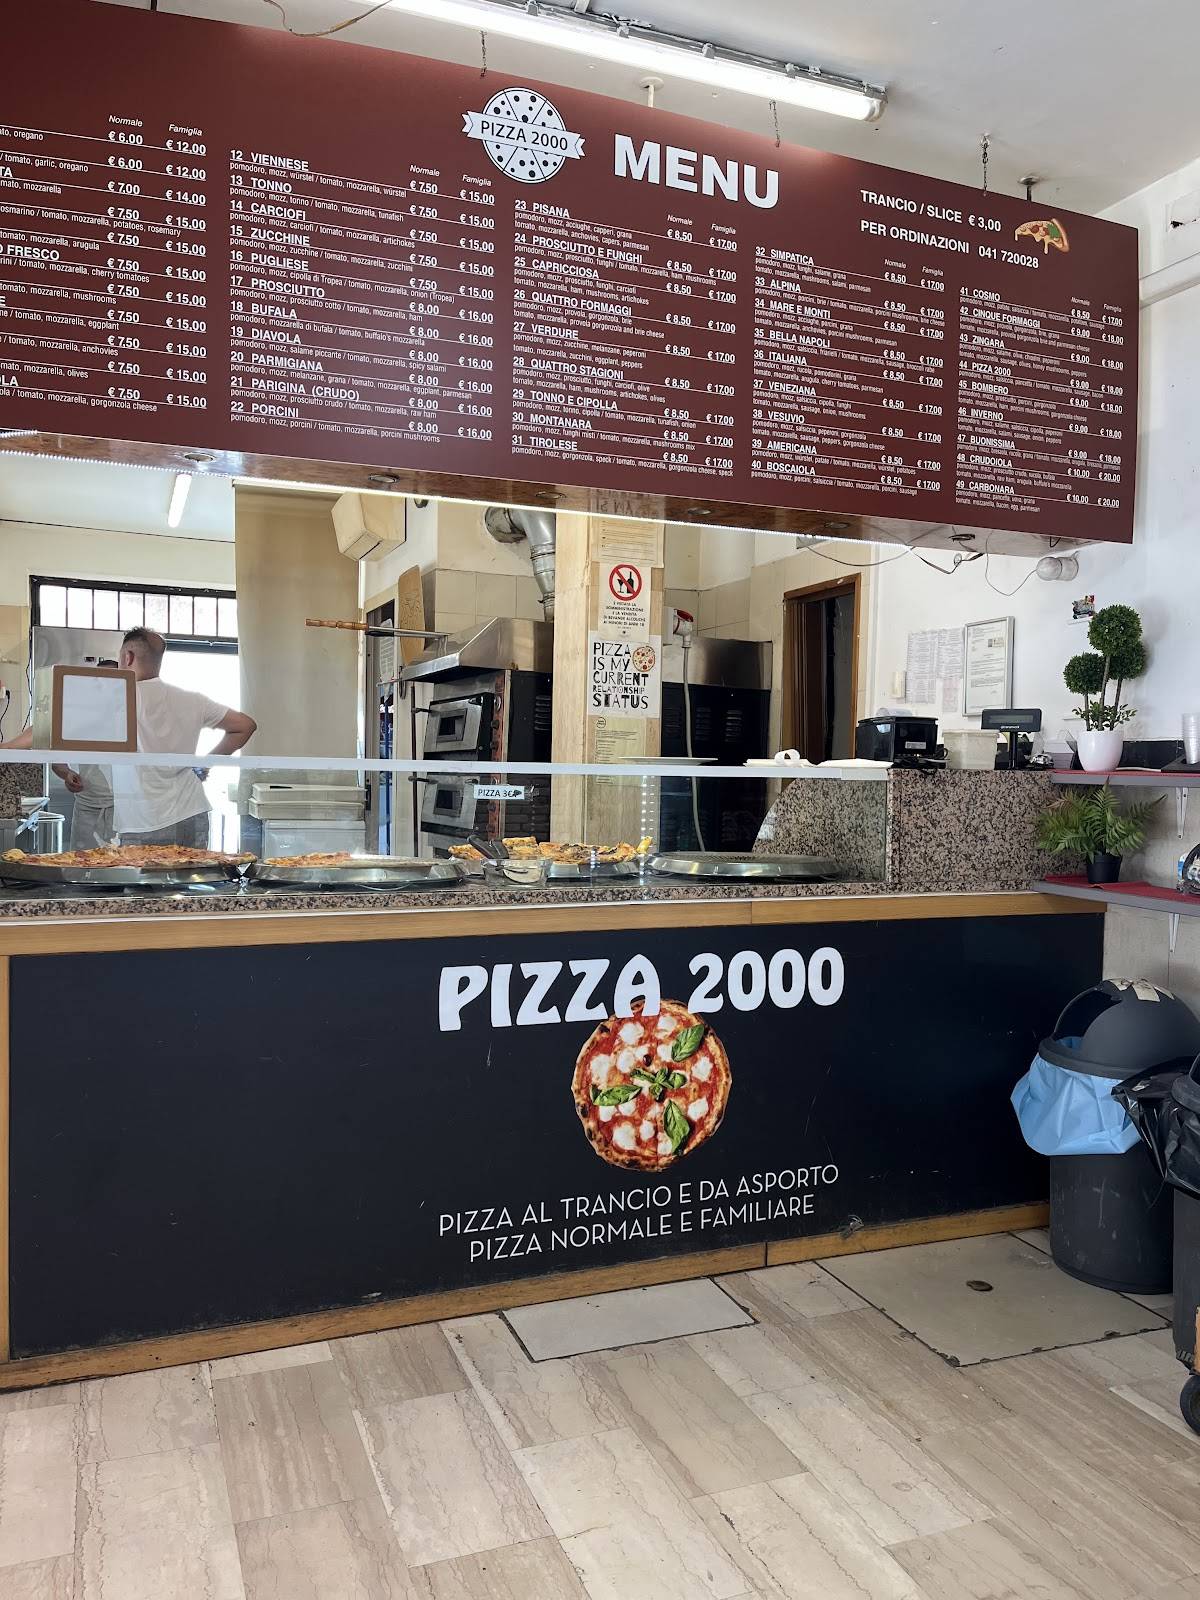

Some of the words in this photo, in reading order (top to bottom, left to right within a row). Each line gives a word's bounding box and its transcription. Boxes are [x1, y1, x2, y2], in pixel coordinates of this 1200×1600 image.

[108, 114, 143, 128] Normale
[168, 124, 203, 137] Famiglia
[14, 130, 44, 140] oregano
[480, 120, 526, 143] PIZZA
[531, 131, 568, 151] 2000
[59, 162, 89, 172] oregano
[230, 149, 242, 160] 12
[250, 152, 309, 171] VIENNESE
[410, 164, 440, 177] Normale
[462, 174, 492, 187] Famiglia
[614, 133, 779, 209] MENU
[23, 182, 62, 194] mozzarella
[230, 175, 242, 186] 13
[250, 177, 292, 193] TONNO
[230, 200, 242, 210] 14
[250, 202, 306, 220] CARCIOFI
[514, 200, 526, 210] 23
[532, 202, 570, 218] PISANA
[860, 190, 916, 214] TRANCIO
[919, 203, 924, 214] /
[927, 205, 963, 223] SLICE
[968, 214, 975, 226] €
[978, 216, 1001, 232] 3,00
[148, 225, 181, 237] rosemary
[667, 214, 693, 226] Normale
[711, 223, 737, 235] Famiglia
[230, 225, 242, 236] 15
[250, 227, 310, 246] ZUCCHINE
[860, 220, 887, 236] PER
[890, 226, 969, 254] ORDINAZIONI
[978, 246, 997, 260] 041
[1001, 250, 1039, 268] 720028
[7, 244, 60, 261] FRESCO
[72, 240, 100, 250] arugula
[514, 233, 526, 243] 24
[532, 236, 595, 256] PROSCIUTTO
[597, 247, 604, 258] E
[606, 248, 642, 264] FUNGHI
[230, 250, 242, 261] 16
[251, 253, 309, 271] PUGLIESE
[755, 246, 765, 256] 32
[770, 249, 814, 266] SIMPATICA
[91, 268, 115, 279] cherry
[116, 272, 150, 283] tomatoes
[514, 256, 526, 266] 25
[532, 259, 599, 279] CAPRICCIOSA
[230, 275, 242, 286] 17
[251, 278, 325, 298] PROSCIUTTO
[755, 276, 765, 286] 33
[770, 279, 801, 293] ALPINA
[73, 291, 116, 304] mushrooms
[514, 289, 526, 299] 26
[531, 291, 578, 309] QUATTRO
[580, 299, 632, 316] FORMAGGI
[960, 287, 968, 296] 41
[973, 288, 1000, 301] COSMO
[231, 301, 243, 311] 18
[251, 303, 297, 319] BUFALA
[754, 298, 765, 308] 34
[770, 300, 795, 313] MARE
[796, 304, 802, 314] E
[804, 306, 830, 319] MONTI
[960, 306, 969, 315] 42
[973, 308, 1001, 321] CINQUE
[1002, 314, 1040, 328] FORMAGGI
[88, 319, 120, 331] eggplant
[514, 322, 525, 331] 27
[531, 324, 578, 339] VERDURE
[231, 326, 243, 337] 19
[251, 328, 301, 344] DIAVOLA
[754, 328, 764, 337] 35
[769, 330, 797, 343] BELLA
[799, 335, 830, 348] NAPOLI
[959, 334, 968, 342] 43
[972, 336, 1005, 349] ZINGARA
[82, 344, 119, 356] anchovies
[769, 352, 807, 365] ITALIANA
[231, 351, 244, 362] 20
[251, 353, 323, 371] PARMIGIANA
[513, 357, 525, 367] 28
[531, 358, 577, 373] QUATTRO
[579, 366, 624, 380] STAGIONI
[959, 360, 968, 369] 44
[972, 362, 992, 373] PIZZA
[994, 366, 1011, 376] 2000
[67, 369, 89, 378] olives
[231, 376, 243, 387] 21
[251, 378, 306, 394] PARIGINA
[312, 384, 359, 402] (CRUDO)
[753, 379, 763, 388] 37
[768, 381, 816, 396] VENEZIANA
[959, 380, 968, 388] 45
[971, 382, 1008, 395] BOMBERO
[90, 398, 131, 410] gorgonzola
[132, 402, 158, 412] cheese
[513, 389, 524, 399] 29
[530, 390, 565, 404] TONNO
[568, 395, 574, 405] E
[576, 397, 618, 411] CIPOLLA
[231, 401, 244, 412] 22
[251, 403, 299, 418] PORCINI
[753, 408, 763, 418] 38
[768, 410, 805, 424] VESUVIO
[958, 407, 966, 416] 46
[971, 408, 1003, 421] INVERNO
[512, 412, 524, 422] 30
[530, 414, 592, 430] MONTANARA
[512, 434, 523, 445] 31
[530, 436, 578, 451] TIROLESE
[752, 438, 762, 448] 39
[767, 440, 817, 455] AMERICANA
[957, 434, 966, 443] 47
[970, 435, 1015, 449] BUONISSIMA
[752, 459, 762, 469] 40
[766, 462, 816, 476] BOSCAIOLA
[956, 480, 965, 489] 49
[968, 481, 1014, 494] CARBONARA
[594, 642, 631, 657] PIZZA
[593, 656, 605, 670] IS
[611, 657, 630, 671] MY
[593, 671, 649, 686] CURRENT
[593, 684, 645, 694] RELATIONSHIP
[592, 693, 649, 709] STATUS
[438, 953, 660, 1031] PIZZA
[687, 946, 845, 1014] 2000
[439, 1206, 513, 1236] PIZZA
[521, 1202, 552, 1227] AL
[560, 1185, 672, 1220] TRANCIO
[679, 1182, 692, 1205] E
[699, 1178, 729, 1202] DA
[736, 1164, 839, 1196] ASPORTO
[470, 1234, 542, 1263] PIZZA
[551, 1214, 672, 1252] NORMALE
[680, 1211, 693, 1232] E
[700, 1194, 815, 1230] FAMILIARE
